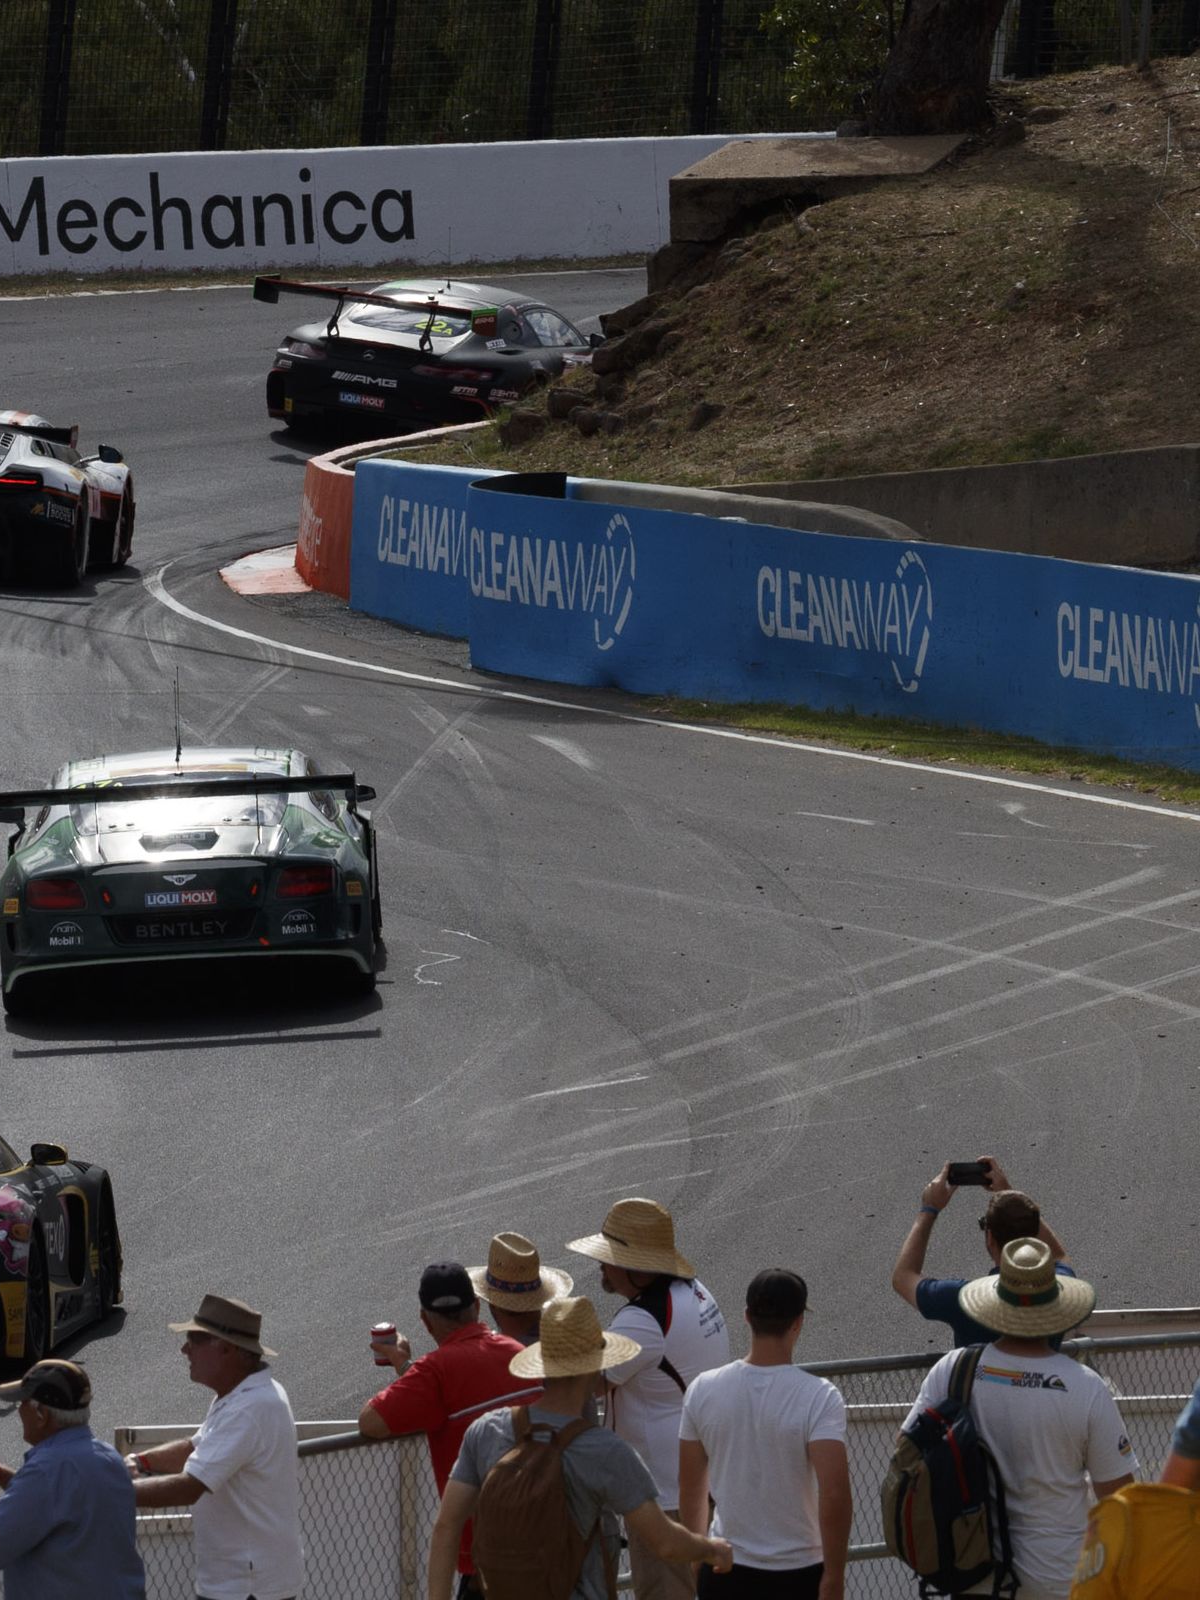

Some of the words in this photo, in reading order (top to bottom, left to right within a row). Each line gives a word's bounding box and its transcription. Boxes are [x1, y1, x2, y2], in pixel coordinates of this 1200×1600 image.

[349, 373, 398, 388] AMG
[361, 394, 385, 410] MOLY
[377, 494, 468, 578] CLEANAW
[469, 526, 627, 616] CLEANAWAY
[757, 565, 924, 656] CLEANAWAY
[1057, 602, 1200, 696] CLEANAWA
[147, 893, 180, 905] LIQUI
[182, 890, 215, 904] MOLY
[135, 920, 228, 938] BENTLEY
[282, 923, 307, 935] Mobil
[49, 935, 75, 947] Mobil
[1022, 1371, 1045, 1380] QUIK
[1010, 1379, 1042, 1389] SILVER
